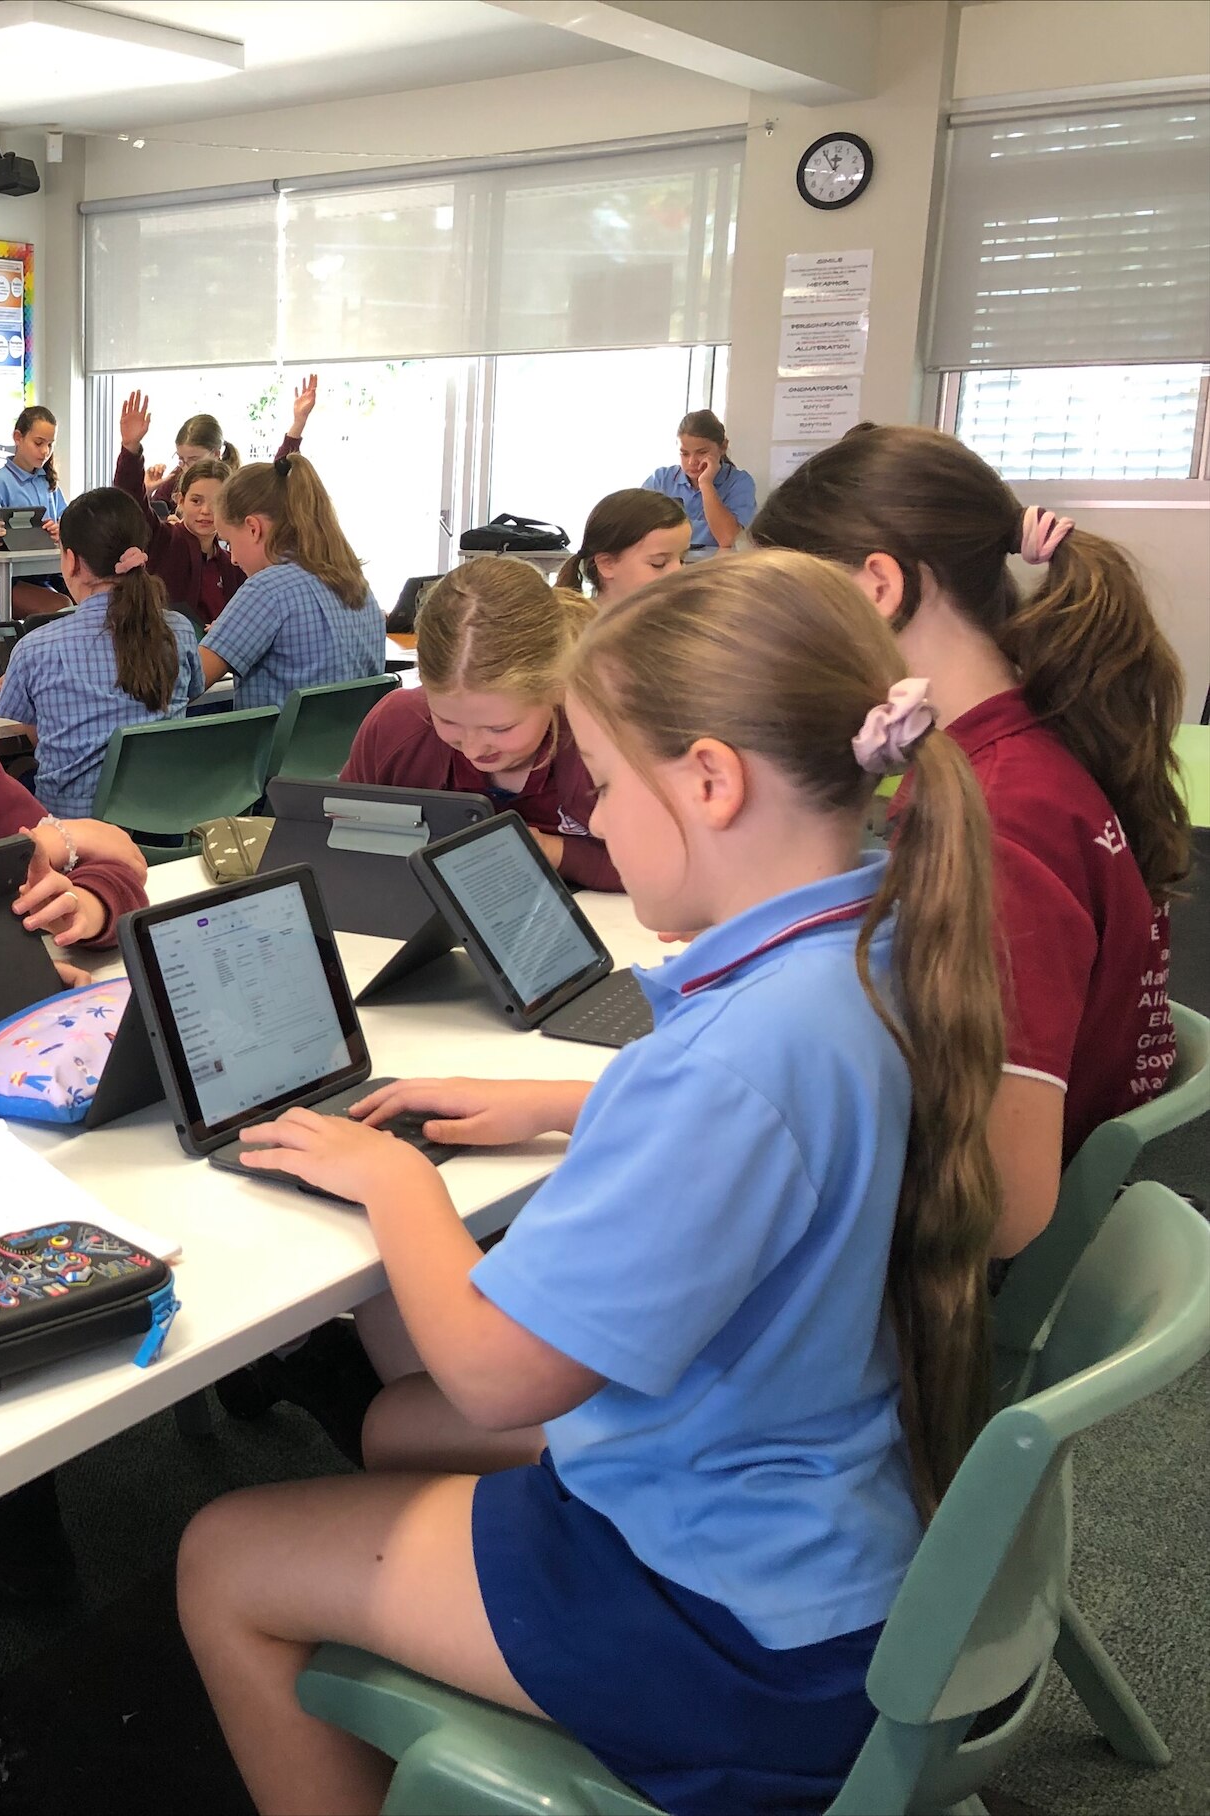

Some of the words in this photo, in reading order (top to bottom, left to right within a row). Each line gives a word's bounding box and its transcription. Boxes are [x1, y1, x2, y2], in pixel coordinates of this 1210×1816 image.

[791, 320, 859, 330] PERSONIFICATION
[795, 344, 851, 352] ALLITERATION
[788, 384, 848, 393] ONOMATOPOEIA
